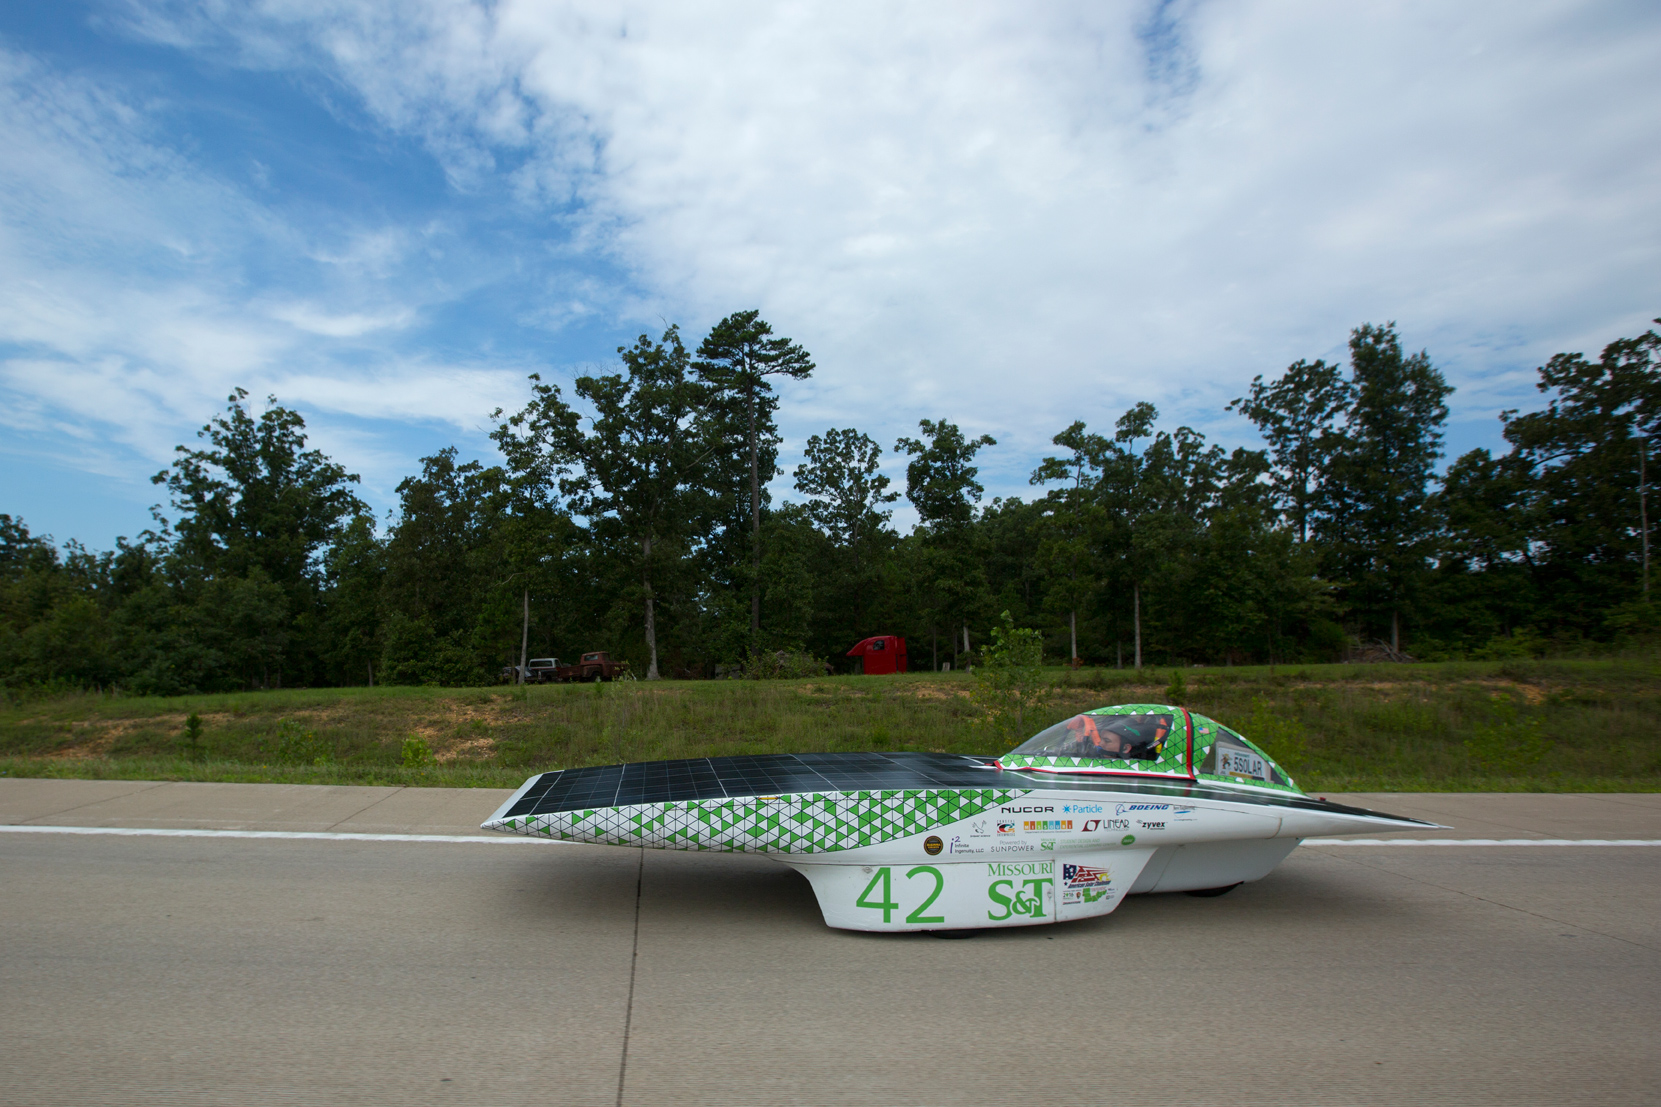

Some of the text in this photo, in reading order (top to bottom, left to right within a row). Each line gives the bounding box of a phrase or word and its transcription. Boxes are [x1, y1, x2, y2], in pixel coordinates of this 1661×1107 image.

[1234, 756, 1262, 776] 5SOLAR
[1072, 804, 1102, 814] Particle
[1103, 819, 1130, 828] LINEAR
[1142, 822, 1165, 830] zyvex
[988, 862, 1053, 876] MISSOURI
[856, 866, 944, 924] 42
[988, 878, 1054, 921] S&T
